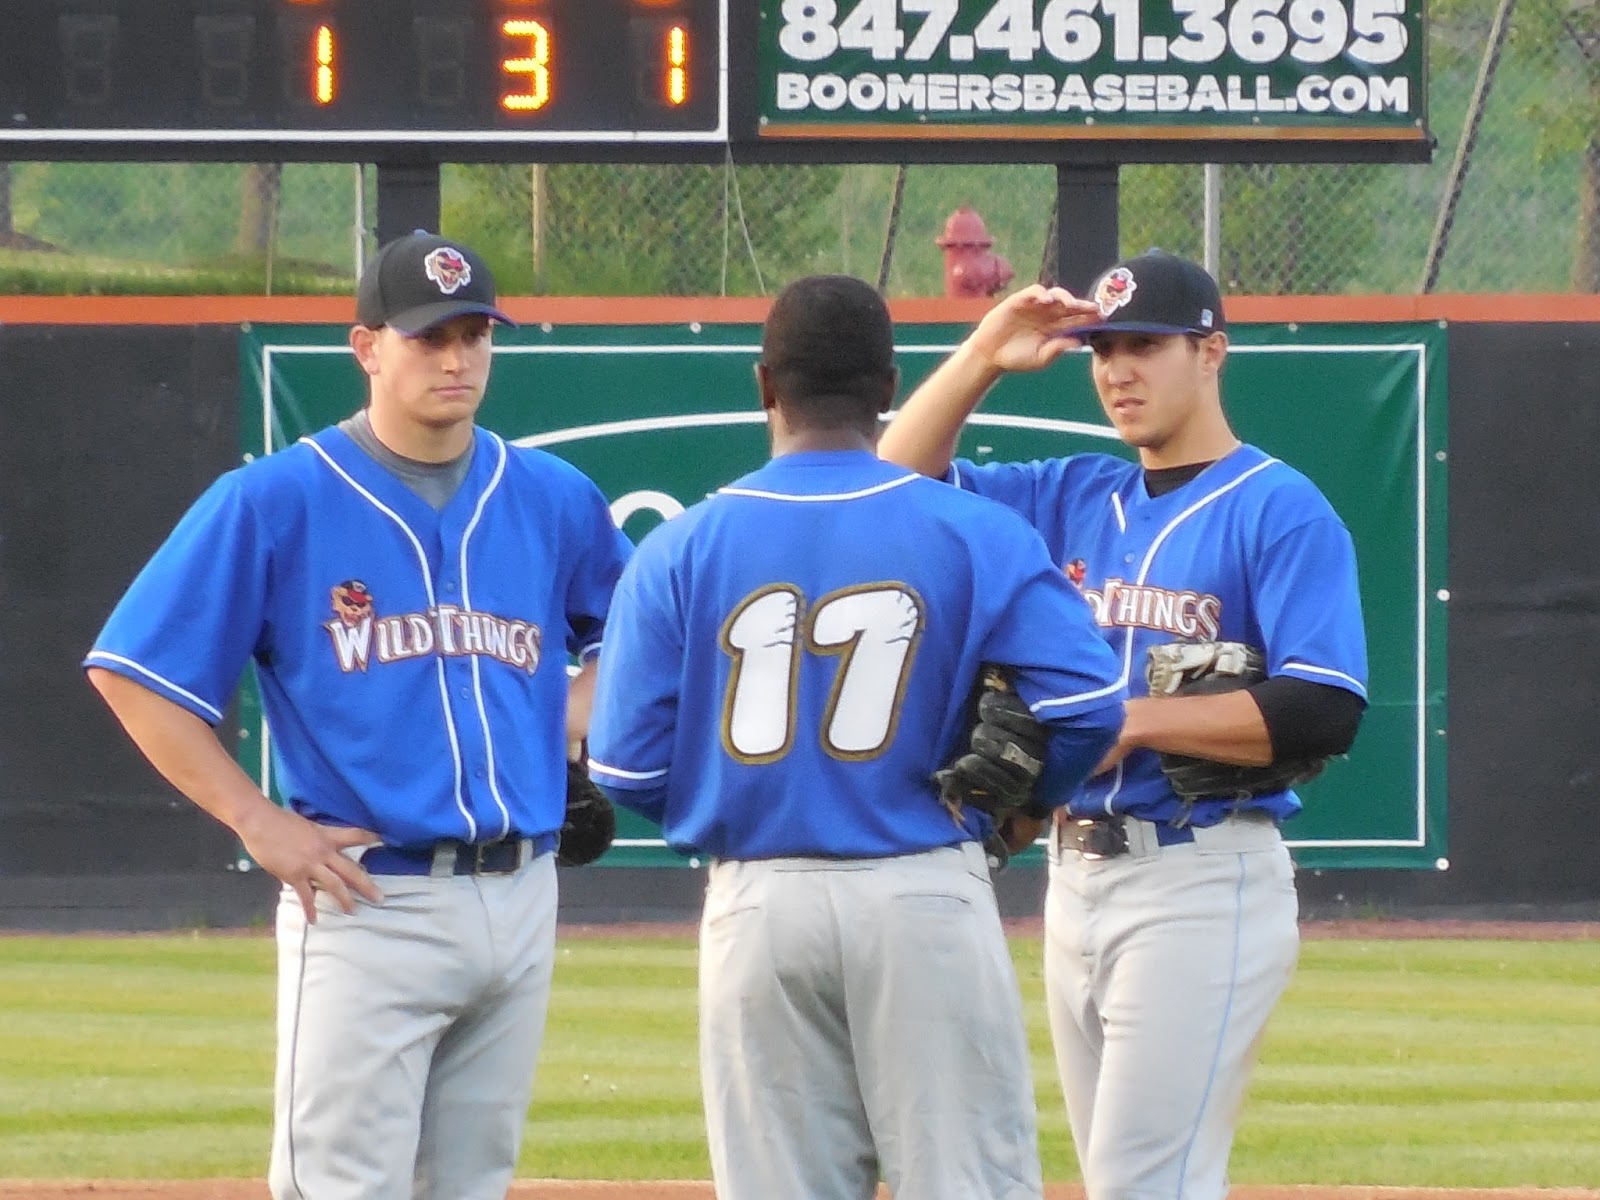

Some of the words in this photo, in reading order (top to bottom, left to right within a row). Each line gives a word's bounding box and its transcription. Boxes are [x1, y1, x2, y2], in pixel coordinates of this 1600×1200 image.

[315, 24, 335, 105] 1
[502, 18, 551, 111] 3
[668, 25, 687, 106] 1
[778, 0, 1409, 64] 847.461.3695
[776, 73, 1410, 113] BOOMERSBASEBALL.COM
[718, 581, 926, 765] 17
